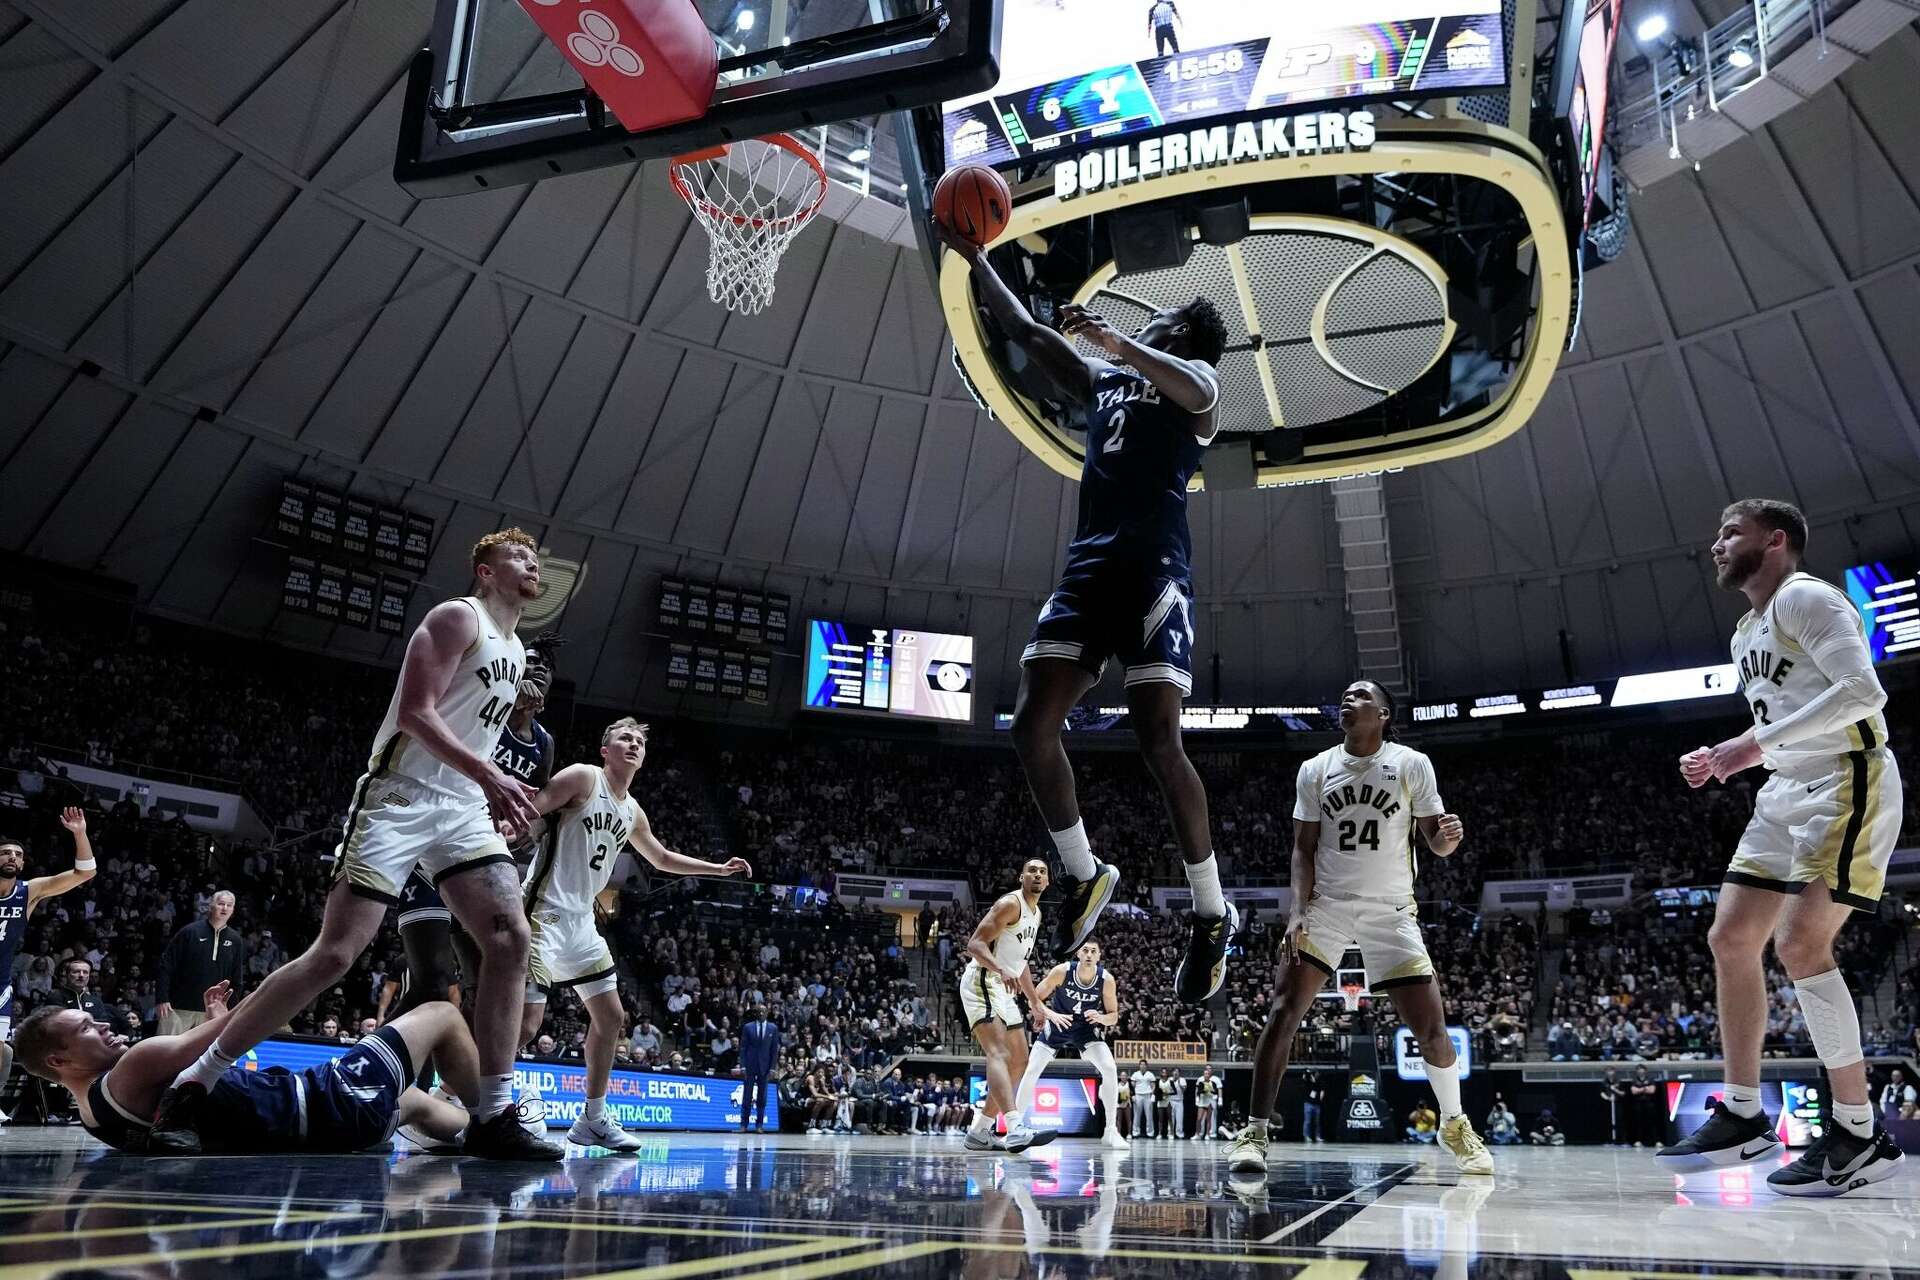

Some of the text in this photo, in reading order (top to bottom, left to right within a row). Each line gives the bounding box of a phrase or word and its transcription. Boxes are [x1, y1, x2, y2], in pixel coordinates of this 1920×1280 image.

[1164, 49, 1244, 83] 15:58
[1043, 98, 1061, 121] 6
[1054, 111, 1376, 200] BOILERMAKERS
[1096, 381, 1161, 413] YALE
[1103, 408, 1127, 455] 2
[1168, 629, 1183, 654] Y
[475, 658, 522, 691] PURD
[1738, 650, 1795, 692] RDUE
[479, 695, 513, 731] 44
[1413, 705, 1445, 721] FOLLOW
[1446, 703, 1458, 718] US
[495, 745, 537, 779] YALE
[1322, 784, 1401, 821] PURDUE
[1338, 819, 1381, 851] 24
[590, 844, 608, 871] 2
[405, 885, 417, 902] Y
[0, 907, 23, 918] LE
[1065, 988, 1099, 1002] YALE
[1072, 1001, 1082, 1014] 4
[1116, 1042, 1166, 1060] DEFENSE
[1167, 1052, 1185, 1060] HERE
[513, 1071, 557, 1094] BUILD,
[561, 1075, 646, 1100] MECNICAL,
[546, 1101, 673, 1122] ERVIC ONTRACTOR
